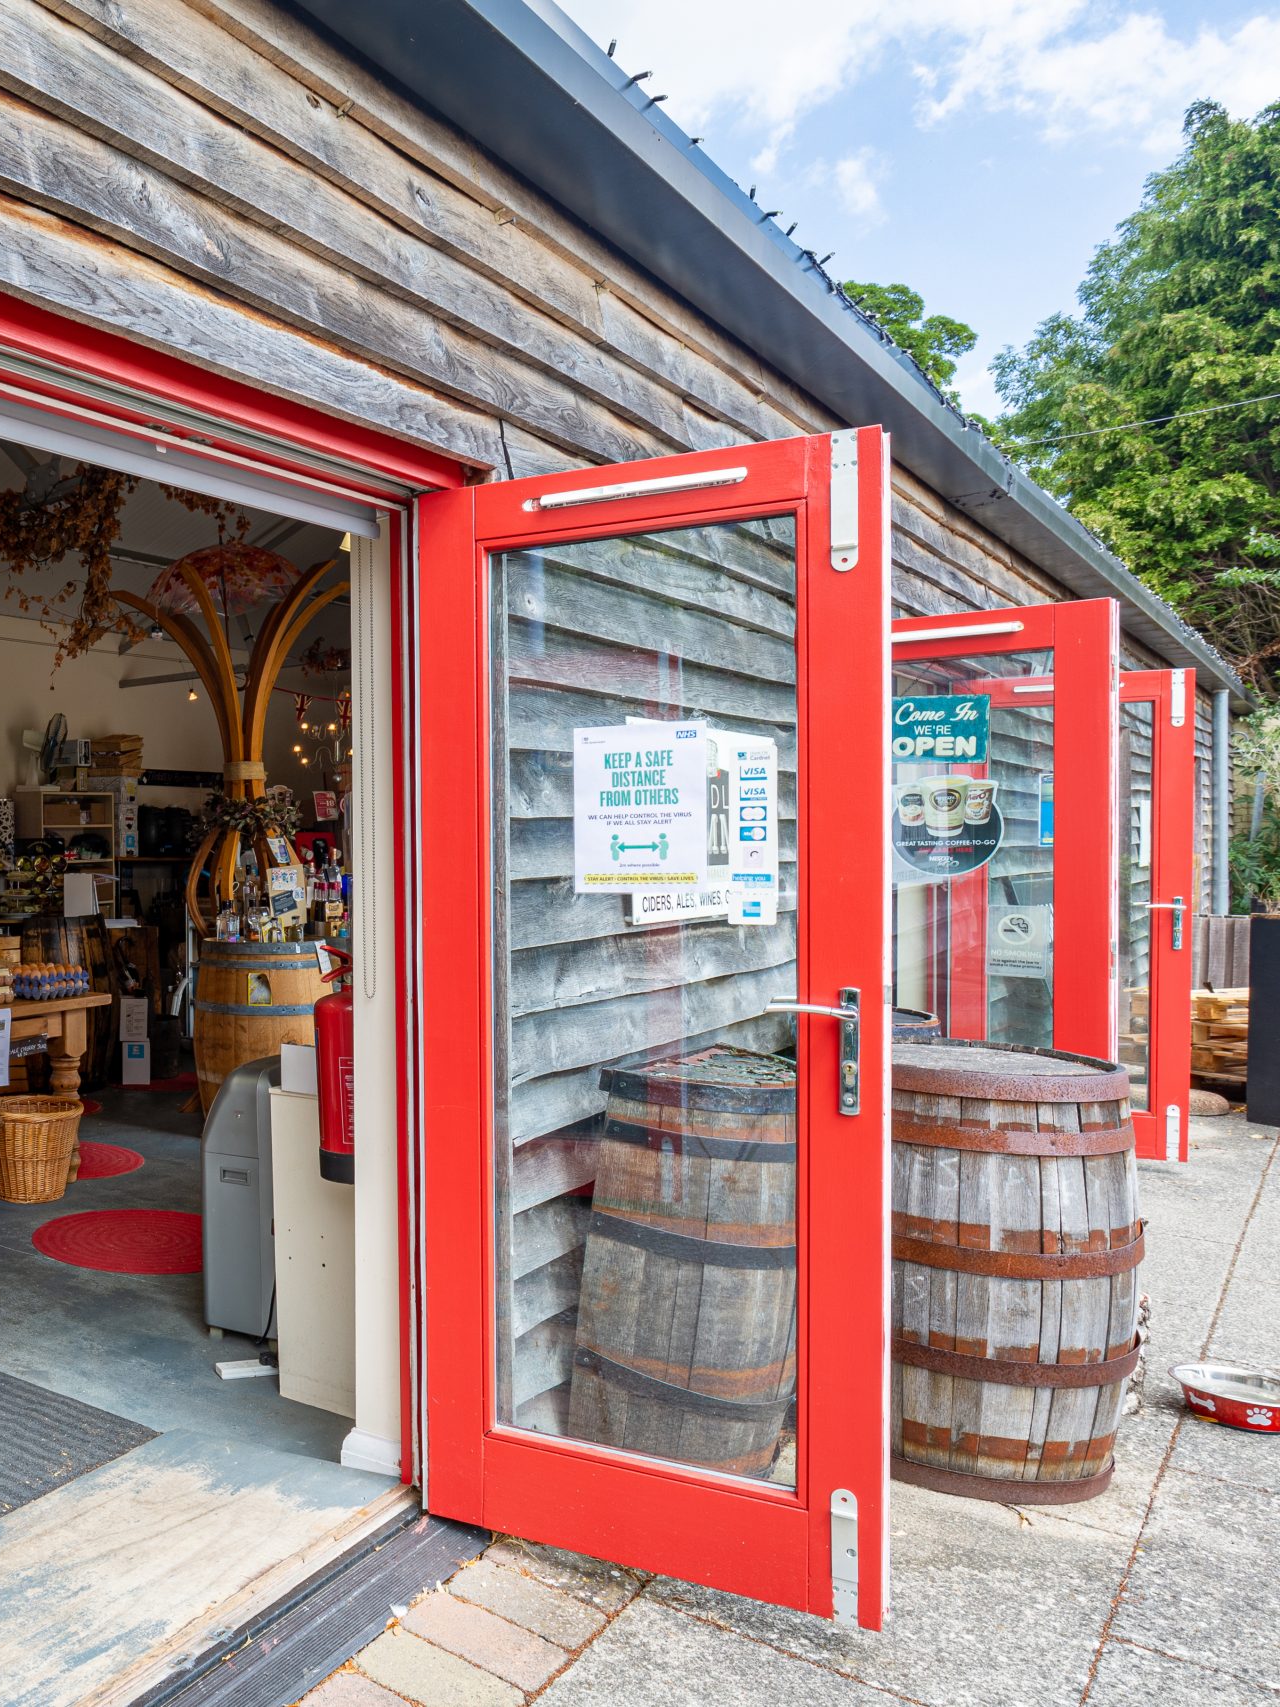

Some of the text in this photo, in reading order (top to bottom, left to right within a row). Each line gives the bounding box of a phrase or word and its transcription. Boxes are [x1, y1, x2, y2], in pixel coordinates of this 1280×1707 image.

[895, 702, 979, 725] Come In
[677, 730, 697, 738] NHS
[914, 724, 952, 735] WE'RE
[892, 735, 977, 757] OPEN
[604, 749, 674, 769] KEEP A SAFE
[611, 769, 666, 788] DISTANCE
[743, 767, 766, 775] VISA
[600, 788, 679, 807] FROM OTHERS
[743, 787, 766, 795] VISA
[641, 894, 674, 913] CIDERS,
[1003, 950, 1042, 959] SMOKING
